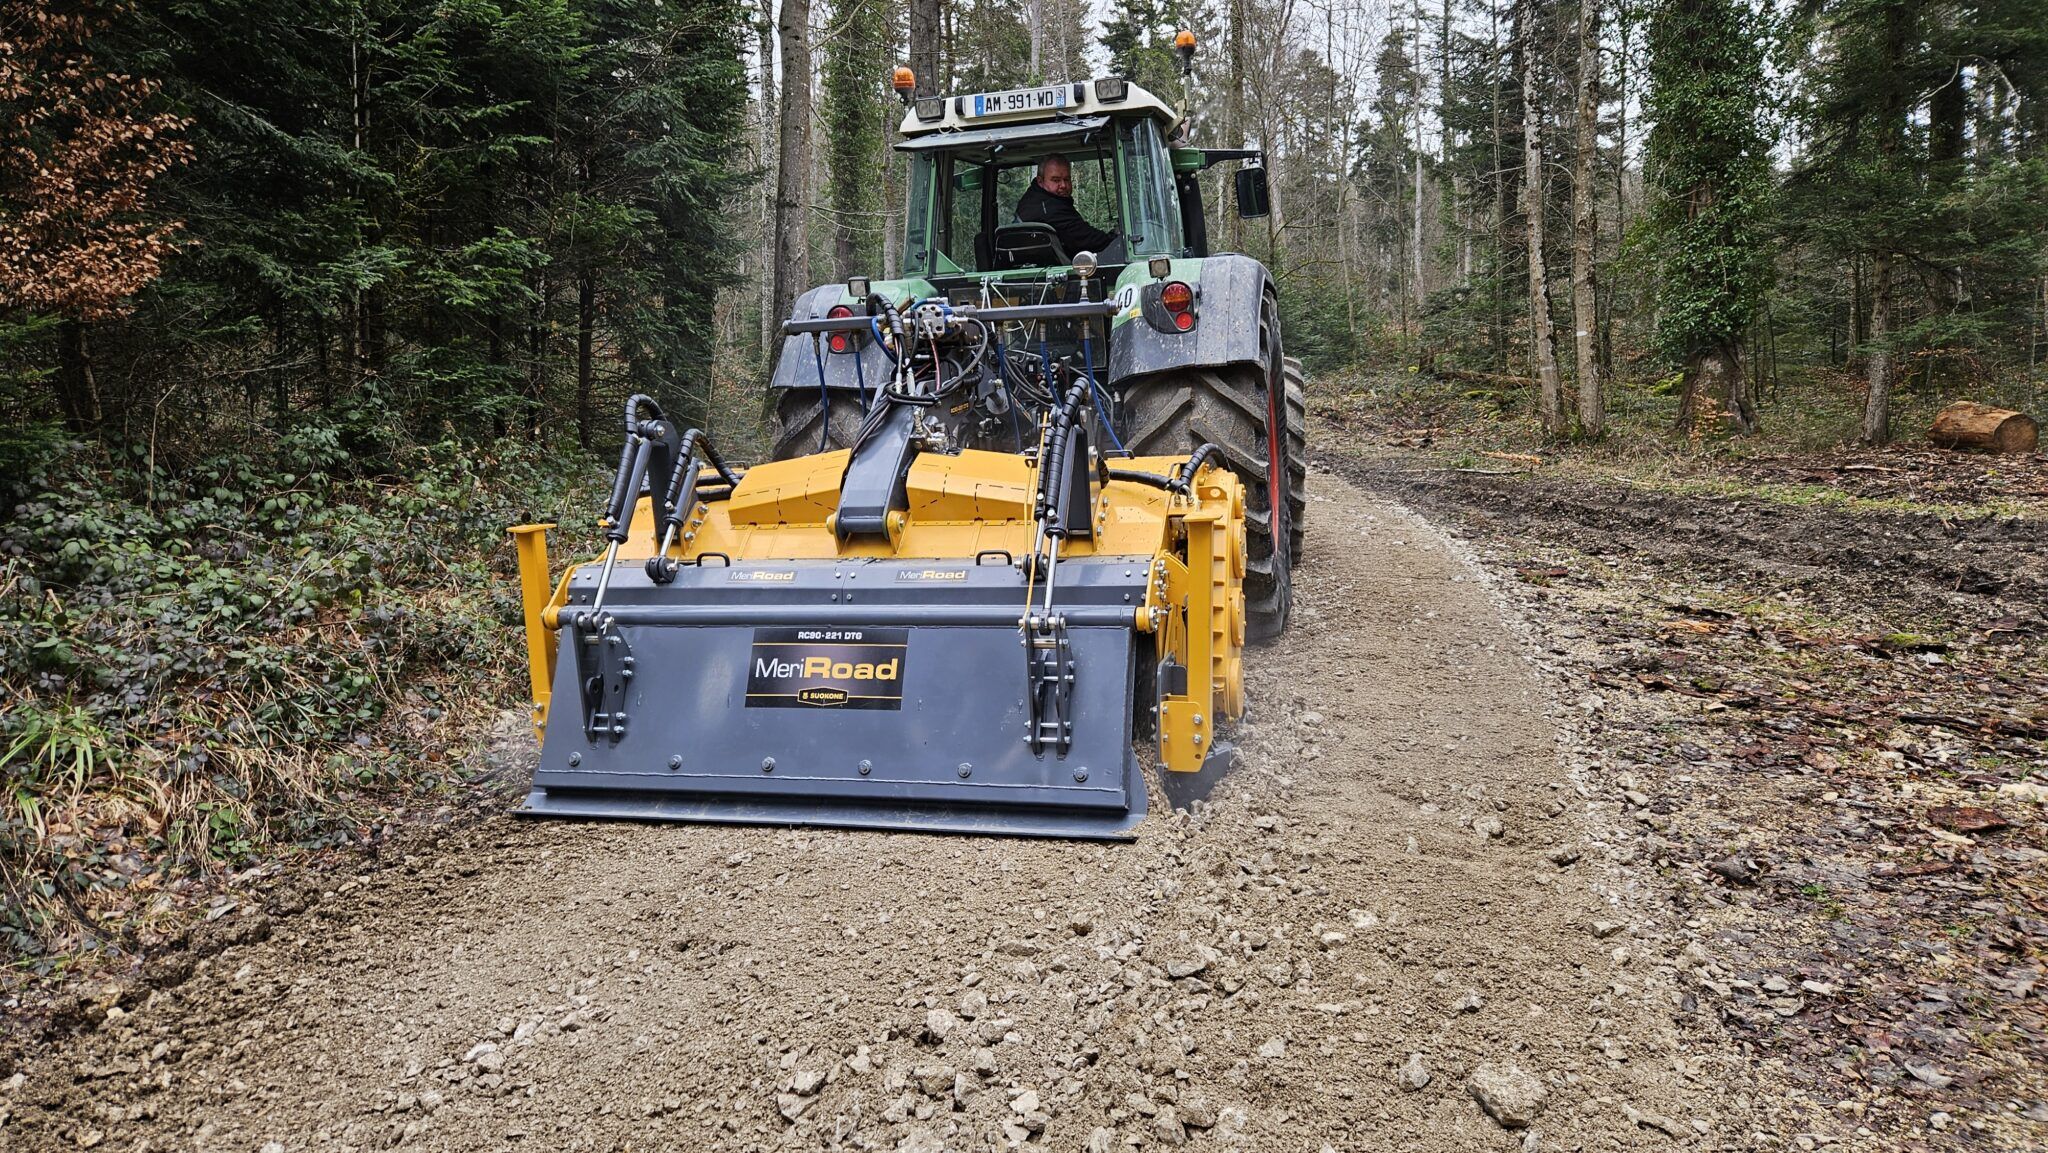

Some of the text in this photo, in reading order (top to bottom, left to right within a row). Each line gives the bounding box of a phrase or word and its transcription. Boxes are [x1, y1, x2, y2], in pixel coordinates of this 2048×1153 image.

[985, 91, 1053, 112] AM-991-WD
[731, 571, 794, 581] MeriRoad
[899, 570, 966, 580] MeriRoad
[844, 631, 862, 640] DTG
[755, 657, 898, 680] MeriRoad
[809, 692, 844, 700] SUOKONE
